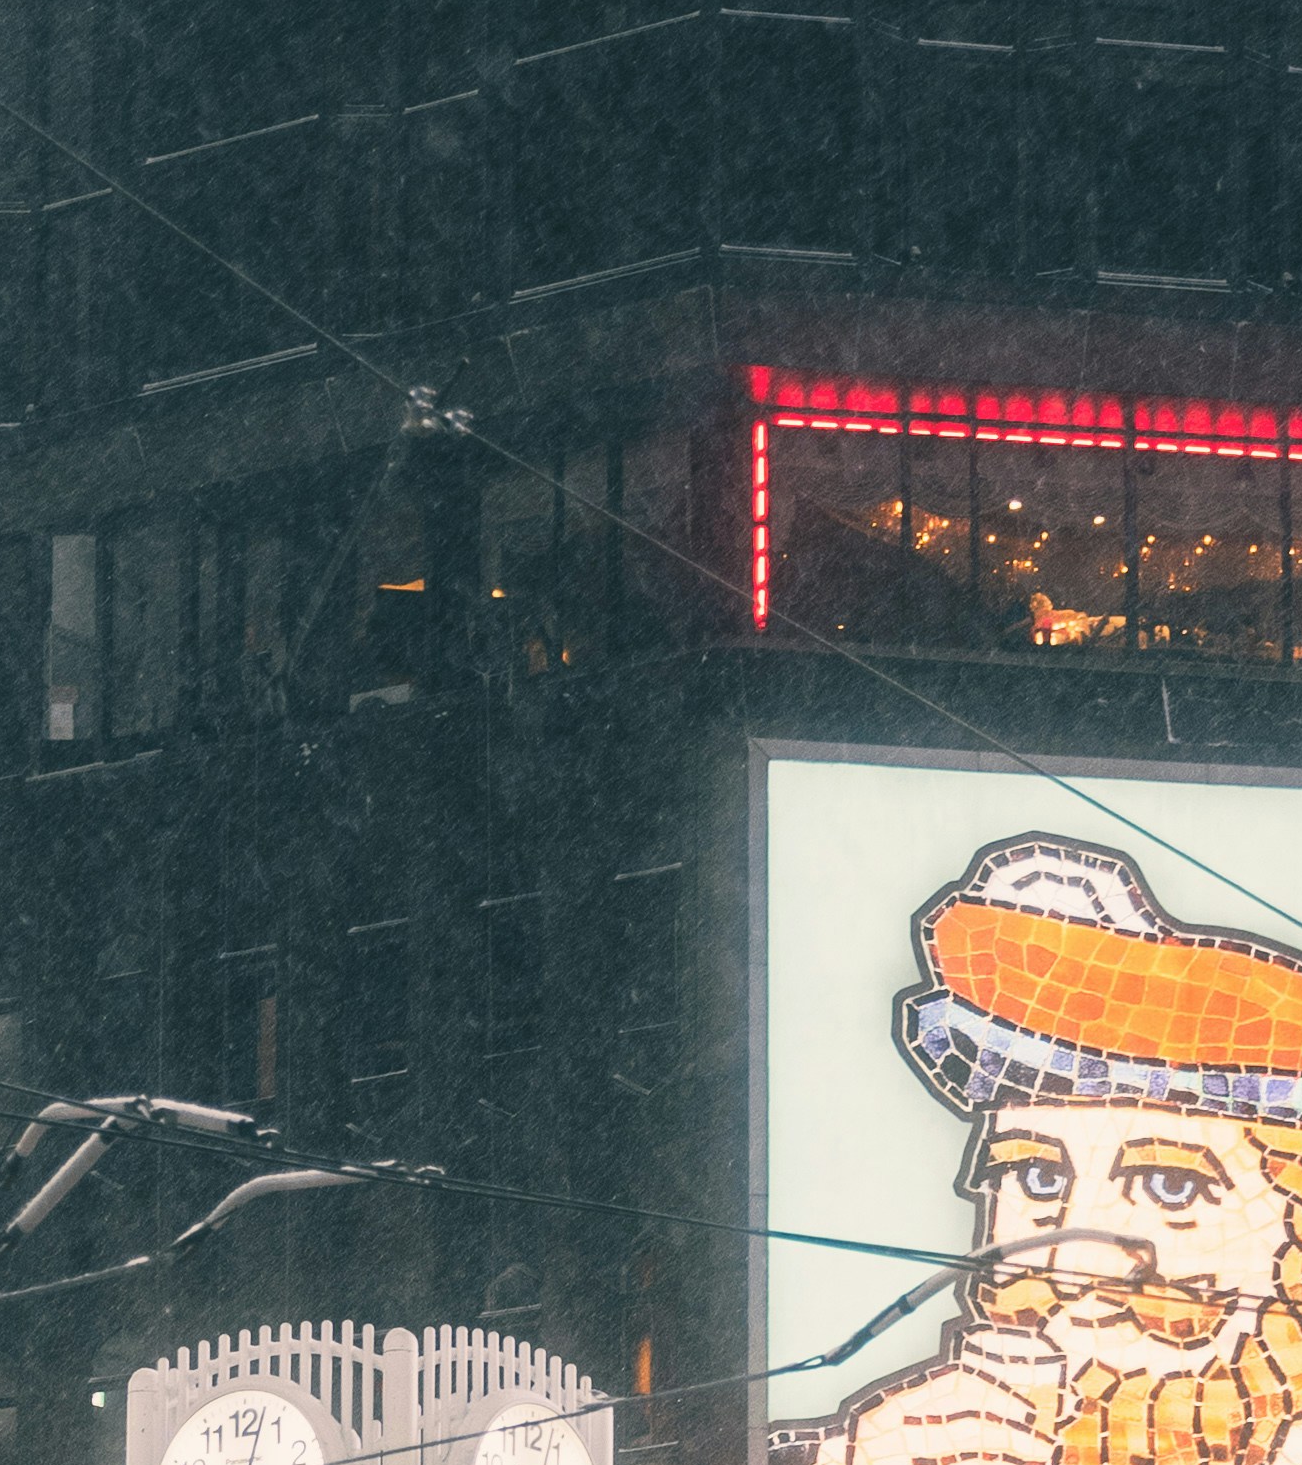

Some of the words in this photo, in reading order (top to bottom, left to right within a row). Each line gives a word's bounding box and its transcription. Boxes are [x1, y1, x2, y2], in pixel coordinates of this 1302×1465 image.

[229, 1408, 259, 1438] 12
[270, 1416, 281, 1445] 1
[200, 1424, 223, 1455] 11
